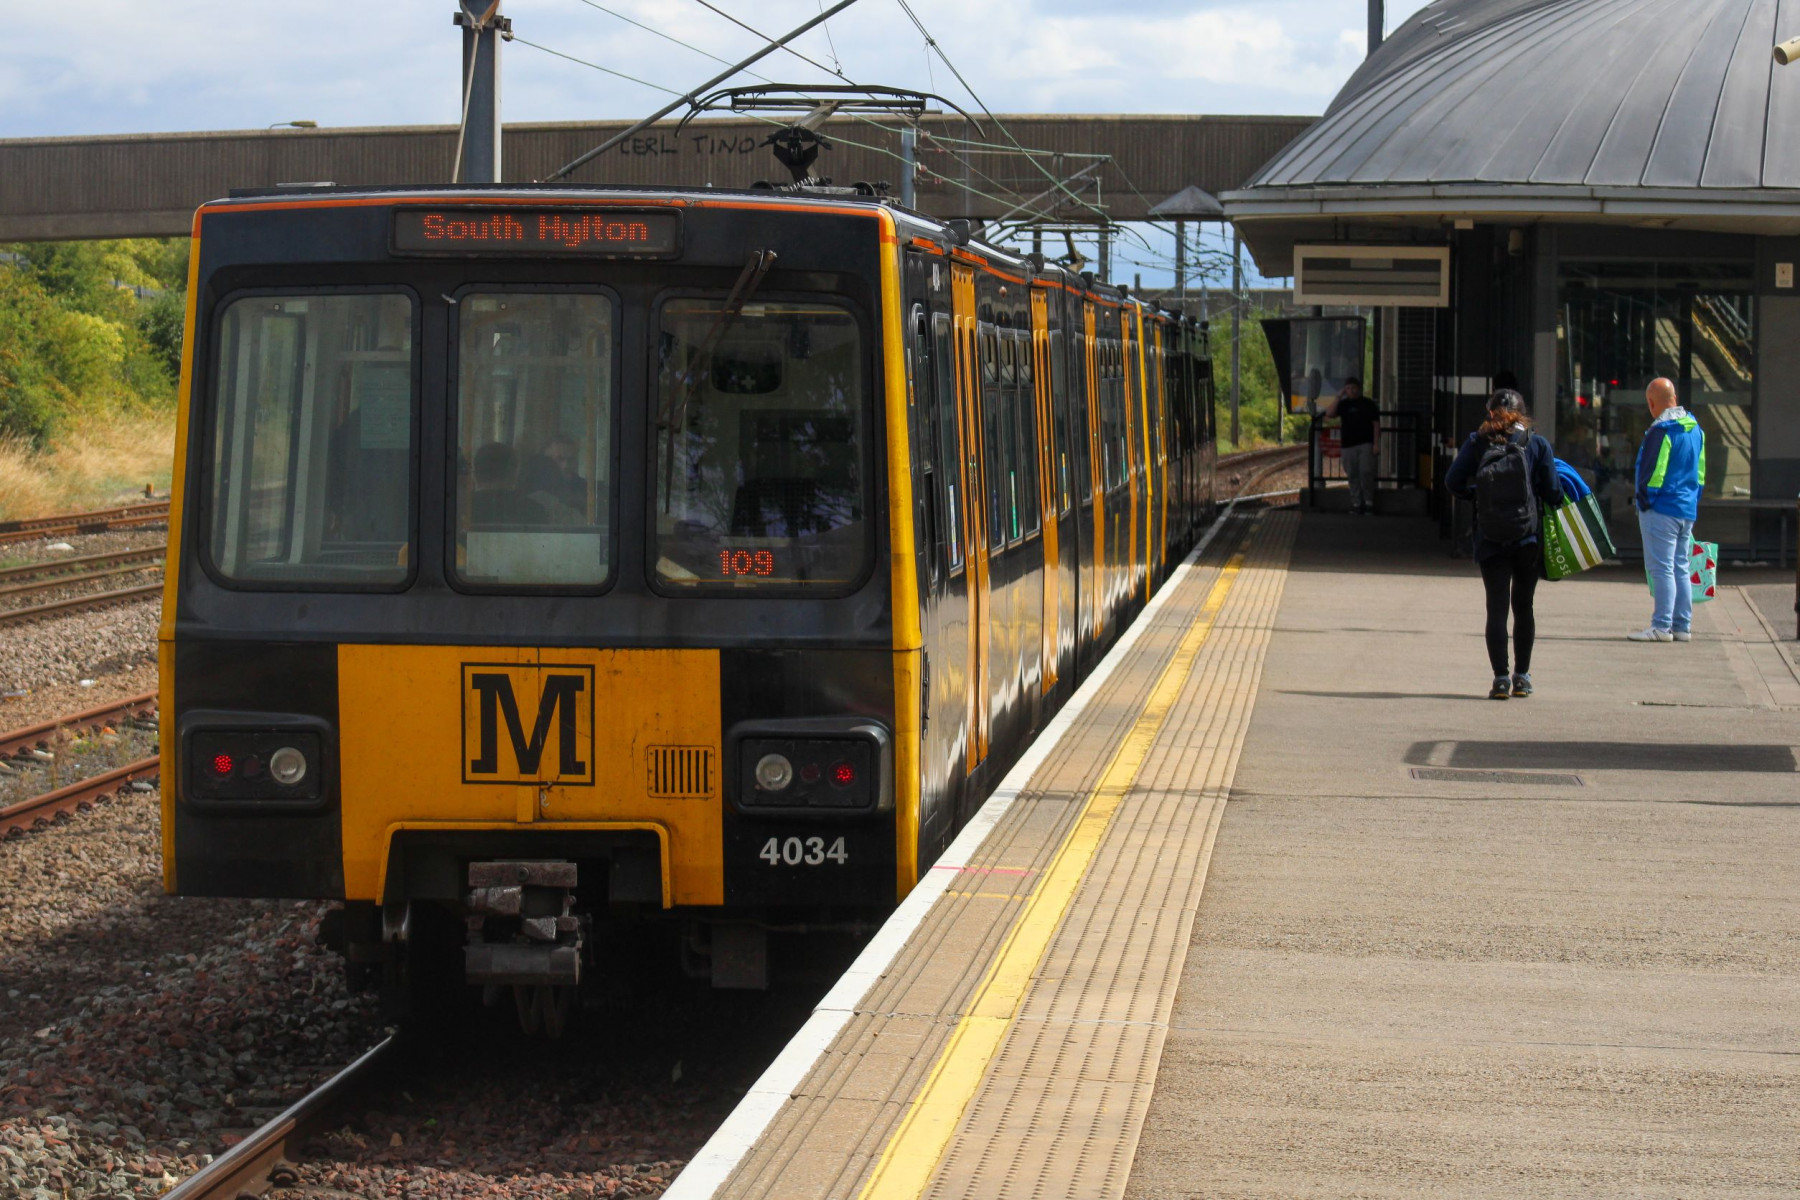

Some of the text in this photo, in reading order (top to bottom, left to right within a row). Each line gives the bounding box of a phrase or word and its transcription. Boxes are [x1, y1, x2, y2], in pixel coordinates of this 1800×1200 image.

[423, 214, 648, 248] South Hylton
[719, 550, 774, 575] 109
[471, 673, 586, 776] M
[759, 836, 849, 866] 4034
